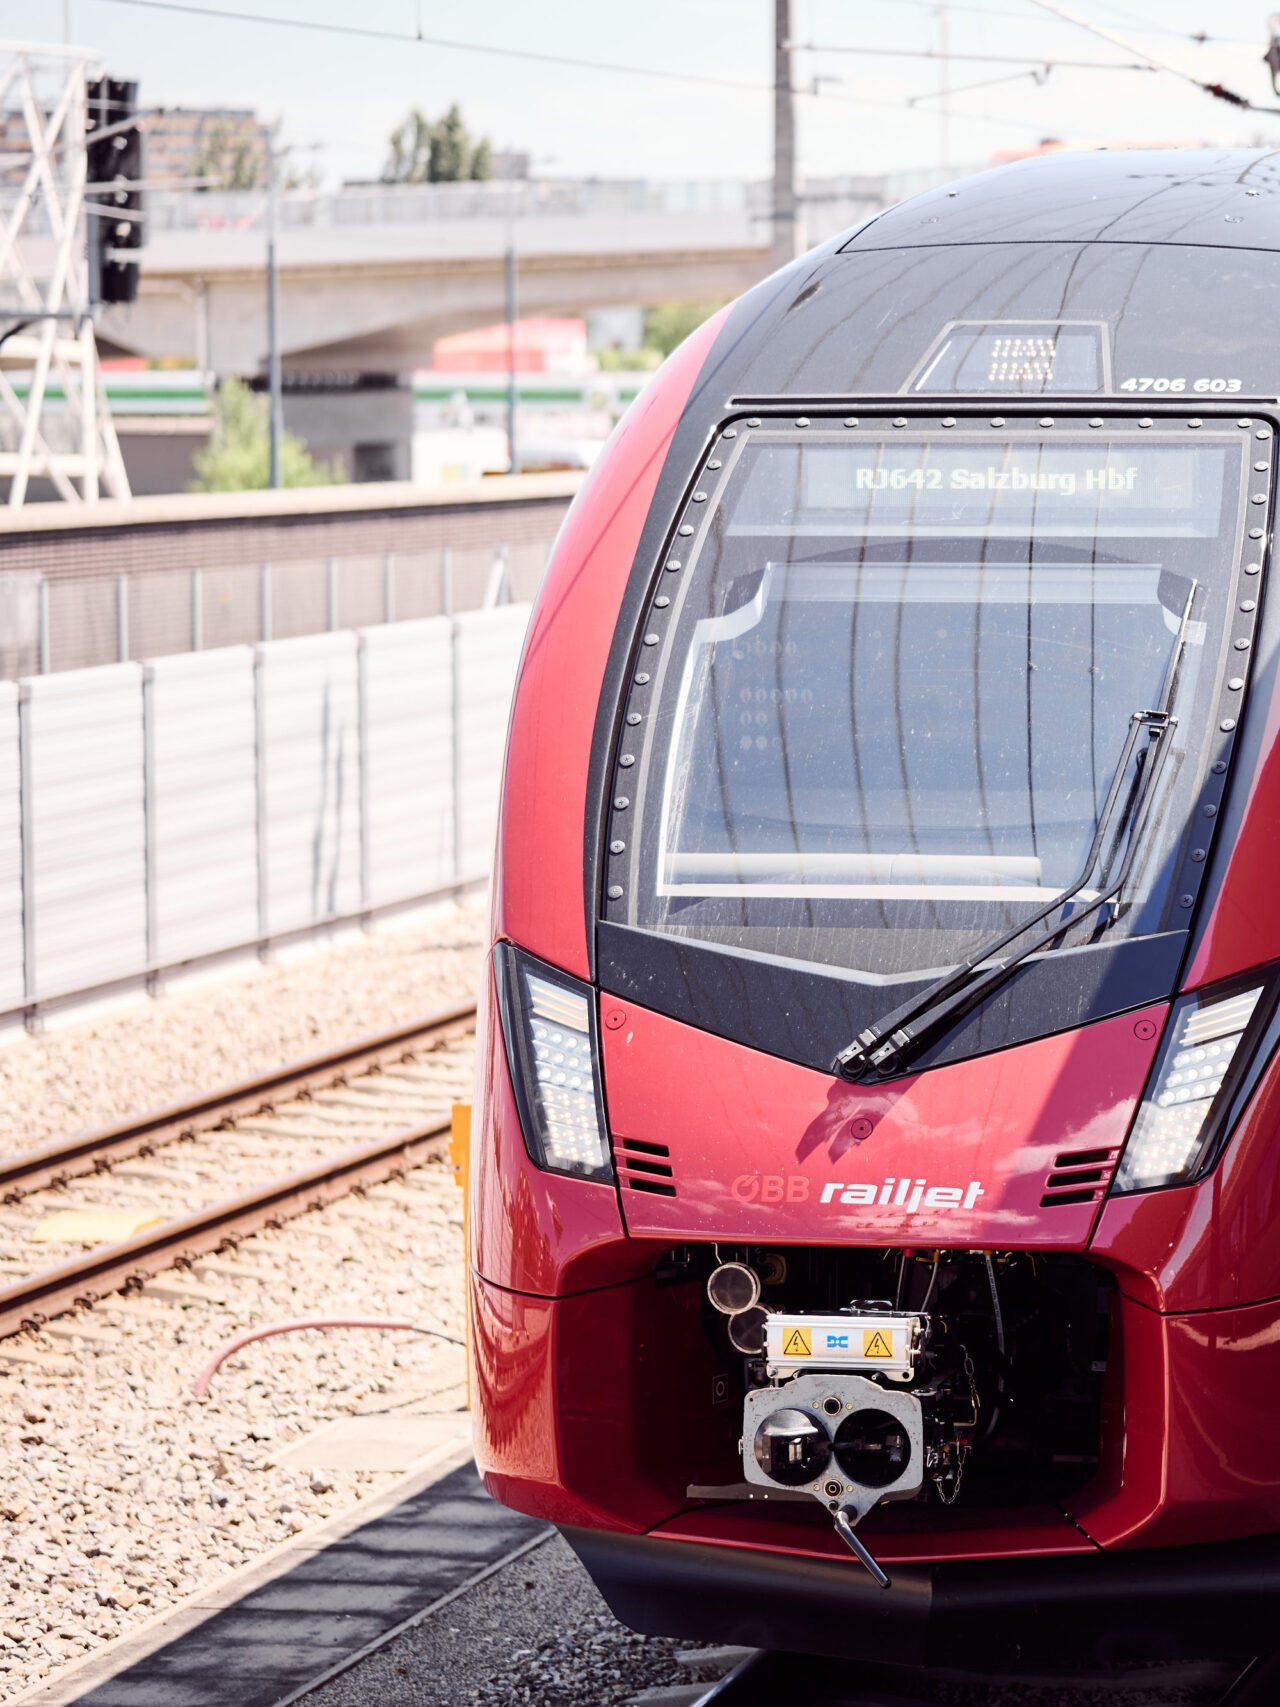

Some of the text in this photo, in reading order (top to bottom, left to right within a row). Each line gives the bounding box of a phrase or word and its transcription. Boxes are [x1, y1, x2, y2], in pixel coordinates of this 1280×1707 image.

[1120, 378, 1242, 392] 4706 603
[856, 467, 1138, 496] RJ642 Salzburg Hbf
[820, 1178, 985, 1213] railjet
